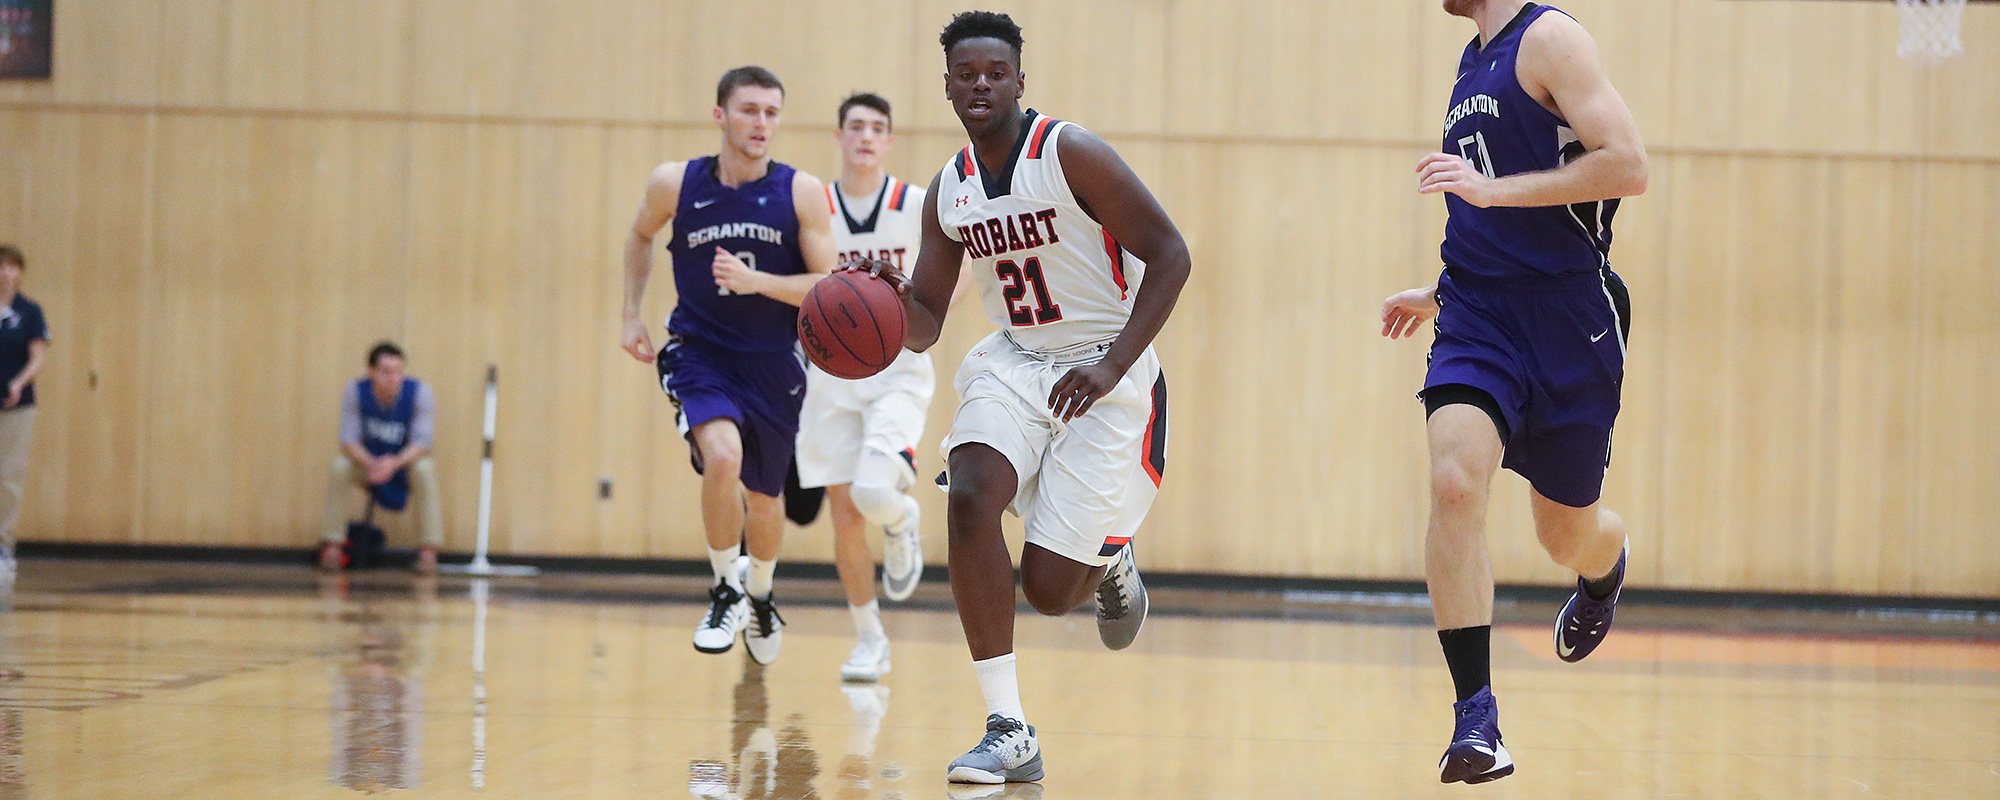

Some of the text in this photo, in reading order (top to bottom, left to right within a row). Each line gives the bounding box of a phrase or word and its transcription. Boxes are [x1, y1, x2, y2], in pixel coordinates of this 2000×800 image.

[1443, 93, 1500, 139] SCRANTON
[687, 222, 782, 249] SCRANTON
[957, 207, 1060, 260] HOBART
[995, 256, 1063, 327] 21
[801, 313, 834, 361] NCAA
